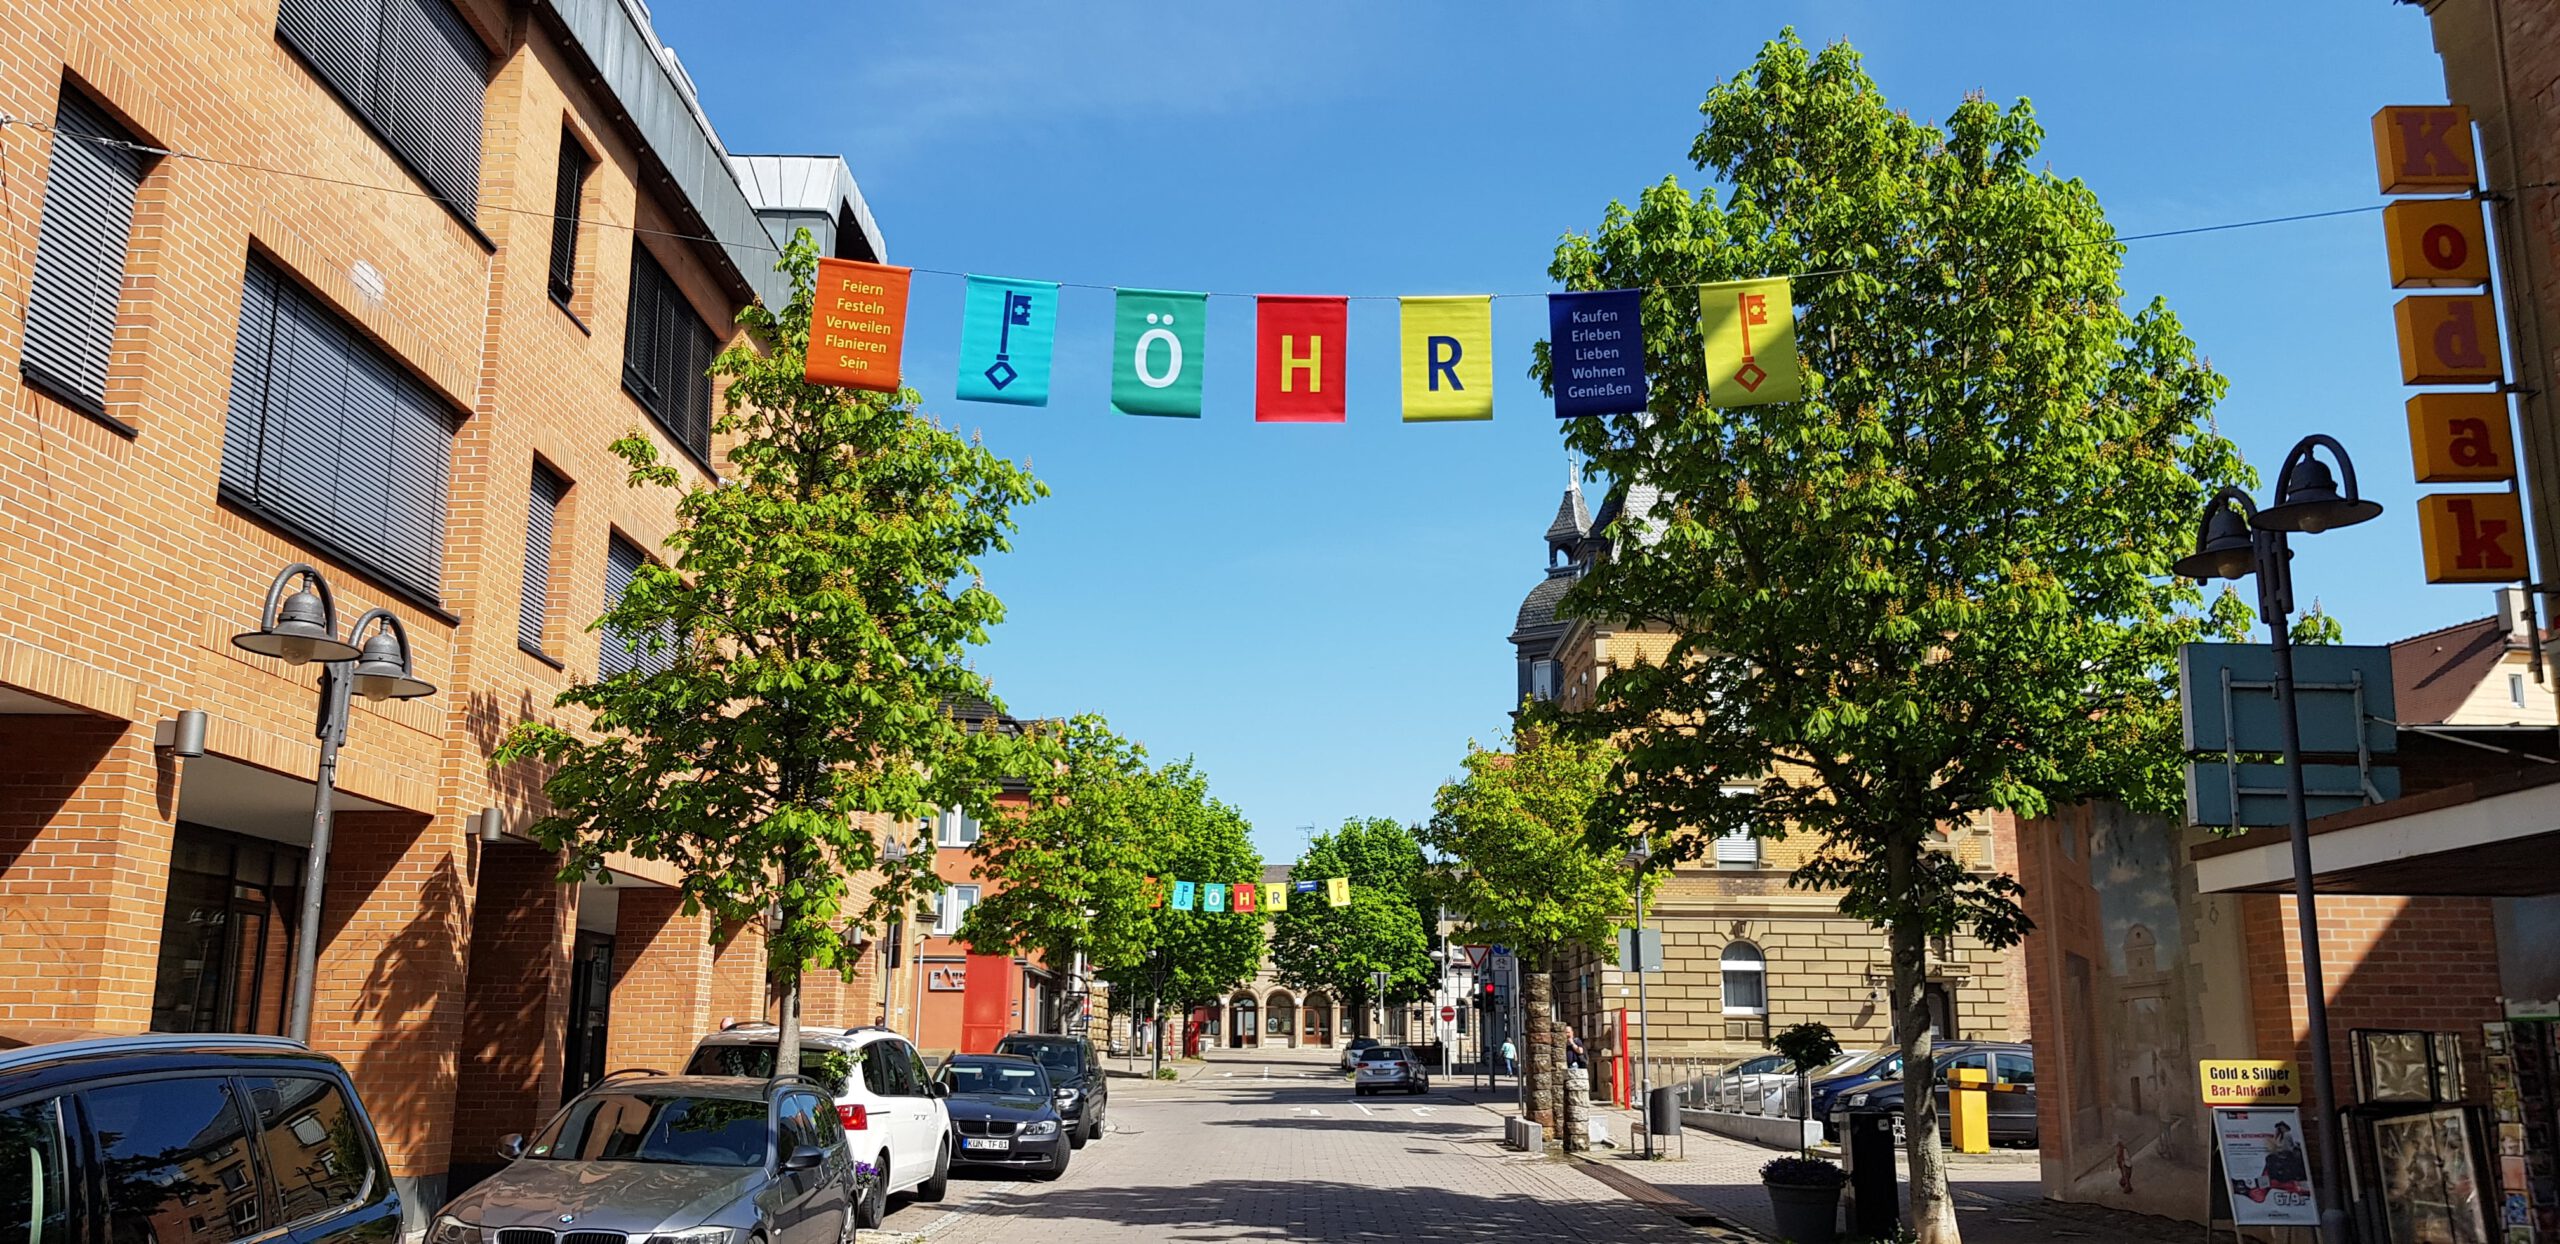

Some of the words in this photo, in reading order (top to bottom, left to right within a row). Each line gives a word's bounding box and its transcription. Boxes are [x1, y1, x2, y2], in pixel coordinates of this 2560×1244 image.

[842, 279, 884, 296] Feiern
[836, 297, 885, 315] Festeln
[1572, 309, 1618, 324] Kaufen
[826, 315, 891, 335] Verweilen
[1571, 328, 1621, 342] Erleben
[2395, 112, 2513, 569] Kodak
[825, 334, 887, 354] Flanieren
[1575, 347, 1620, 361] Lieben
[839, 355, 868, 370] Sein
[1571, 365, 1626, 380] Wohnen
[1568, 383, 1632, 398] Genießen
[2210, 1067, 2238, 1080] Gold
[2241, 1069, 2250, 1080] &
[2252, 1067, 2290, 1080] Silber
[2211, 1084, 2276, 1096] Bar-Ankauf
